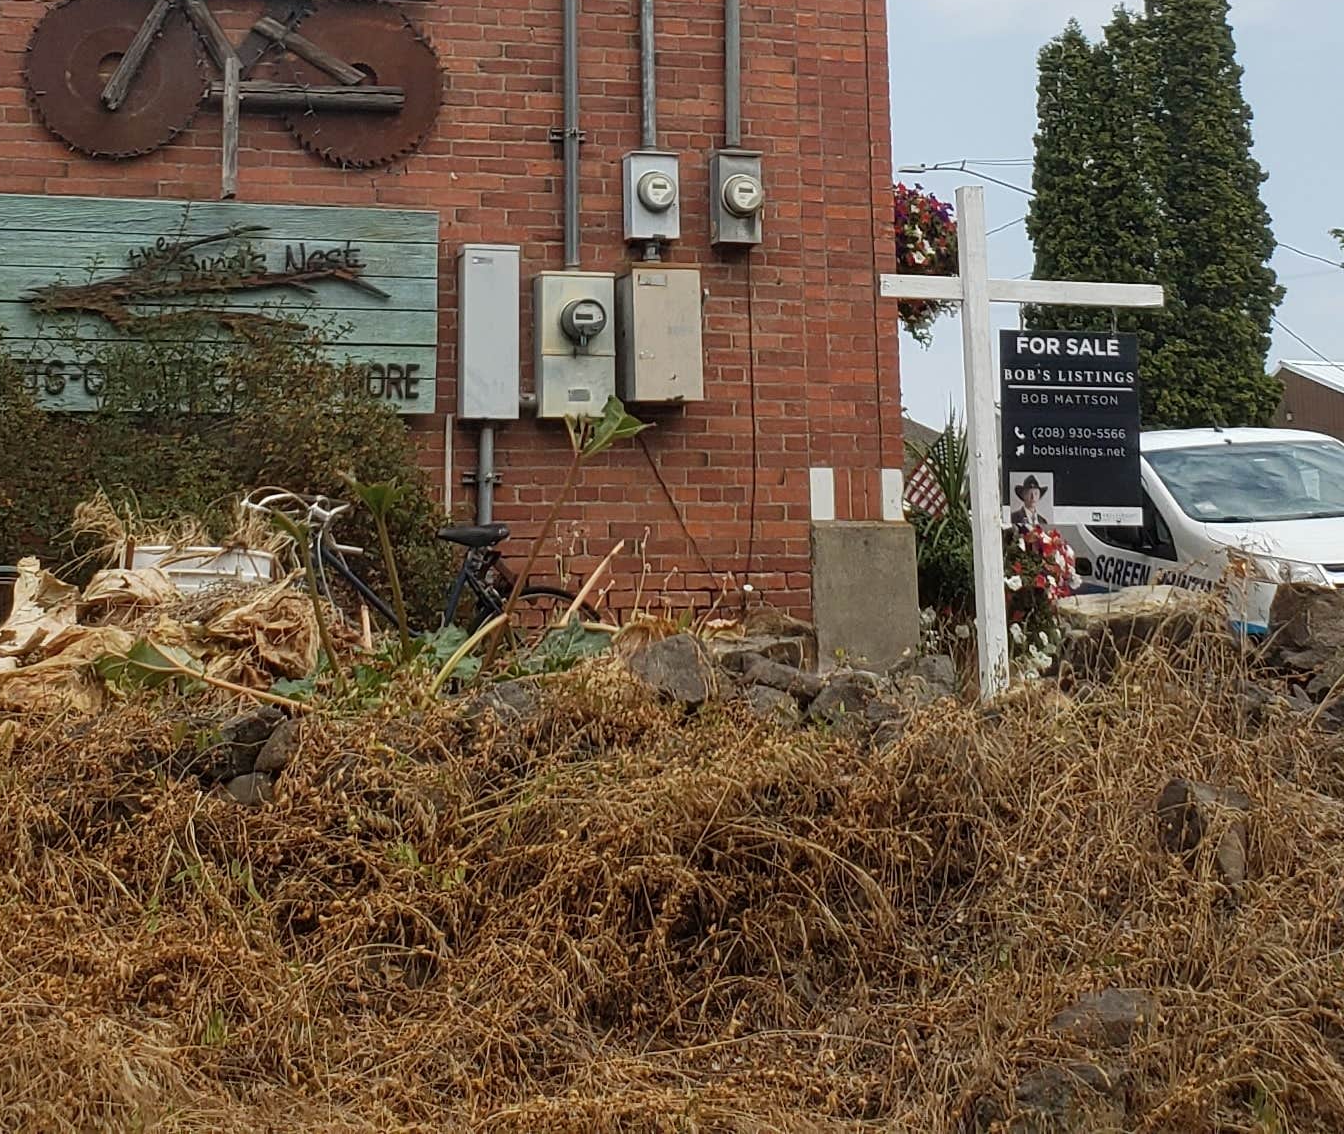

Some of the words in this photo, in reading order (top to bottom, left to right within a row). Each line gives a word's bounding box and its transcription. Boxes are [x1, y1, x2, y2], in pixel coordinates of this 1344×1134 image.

[285, 240, 361, 274] Nest
[1016, 337, 1060, 354] FOR
[1066, 338, 1121, 357] SALE
[1004, 368, 1051, 381] BOB'S
[1058, 370, 1135, 383] LISTINGS
[1021, 393, 1049, 404] BOB
[1054, 394, 1119, 406] MATTSON
[1031, 426, 1065, 439] (208)
[1068, 428, 1127, 440] 930-5566
[1032, 444, 1127, 458] bobslistings.net
[1095, 554, 1152, 587] SCREEN
